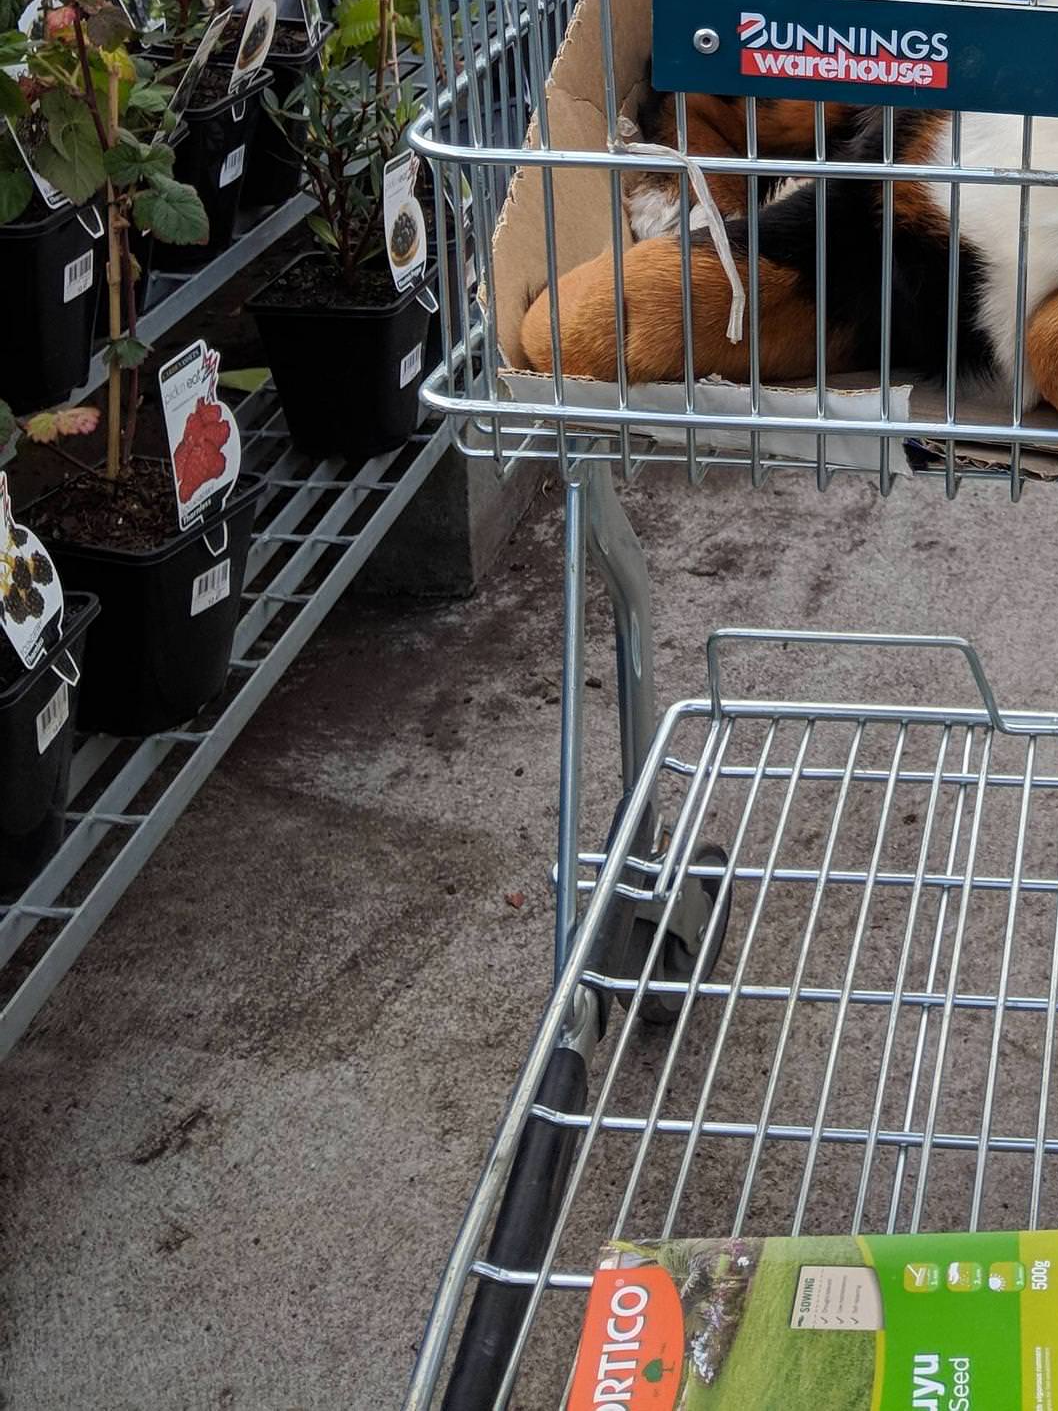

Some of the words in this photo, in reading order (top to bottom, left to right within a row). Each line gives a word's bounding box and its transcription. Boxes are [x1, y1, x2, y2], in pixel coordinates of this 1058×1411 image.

[737, 11, 948, 62] BUNNINGS
[753, 48, 933, 85] warehouse
[1031, 1260, 1051, 1290] 500g
[799, 1277, 816, 1313] SOWING
[948, 1357, 970, 1411] Seed
